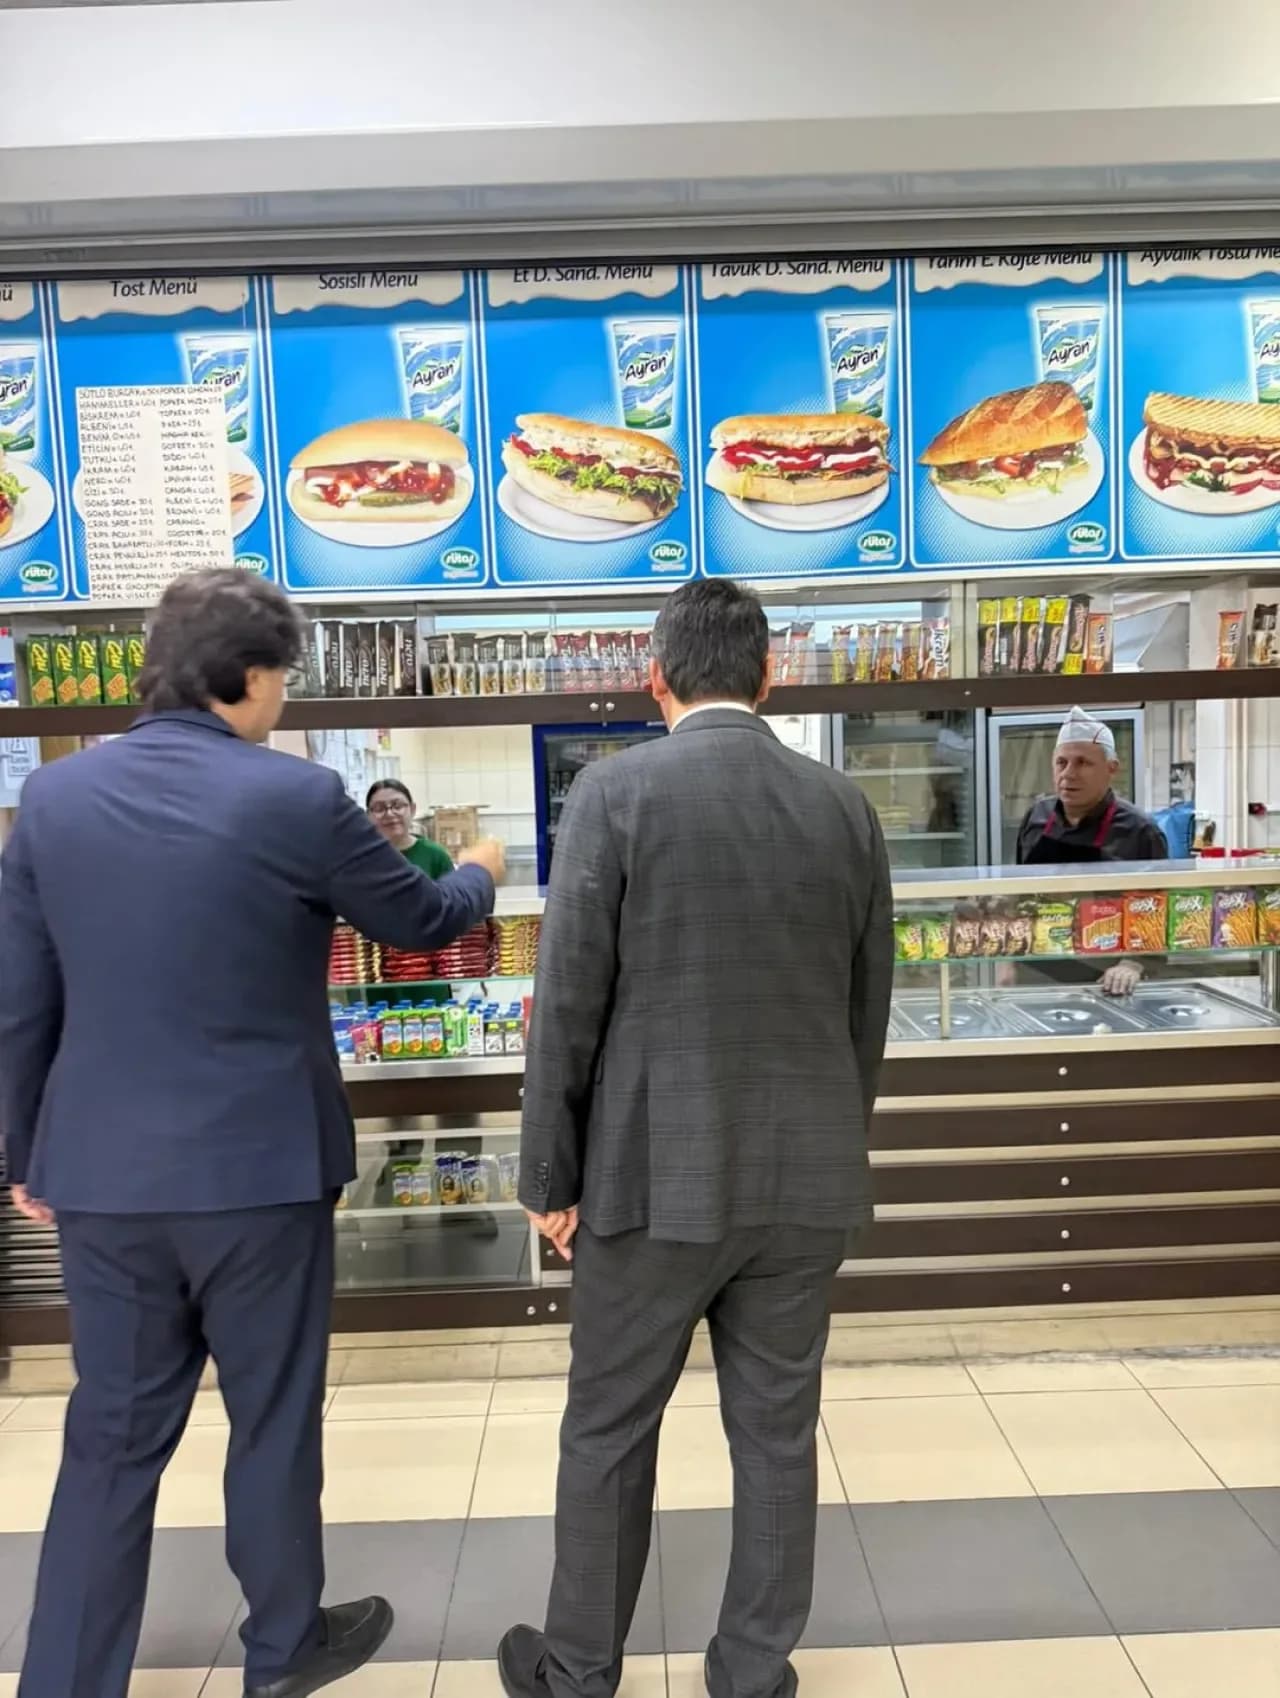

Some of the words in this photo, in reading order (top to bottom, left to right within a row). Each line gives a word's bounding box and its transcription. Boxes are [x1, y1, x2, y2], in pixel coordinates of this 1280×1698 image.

[110, 279, 145, 297] Tost
[150, 277, 198, 296] Menü
[513, 267, 528, 283] Et
[837, 348, 878, 373] Ayran
[1048, 341, 1090, 365] Ayran
[412, 362, 454, 388] Ayran
[626, 355, 667, 380] Ayran
[0, 379, 27, 402] yran
